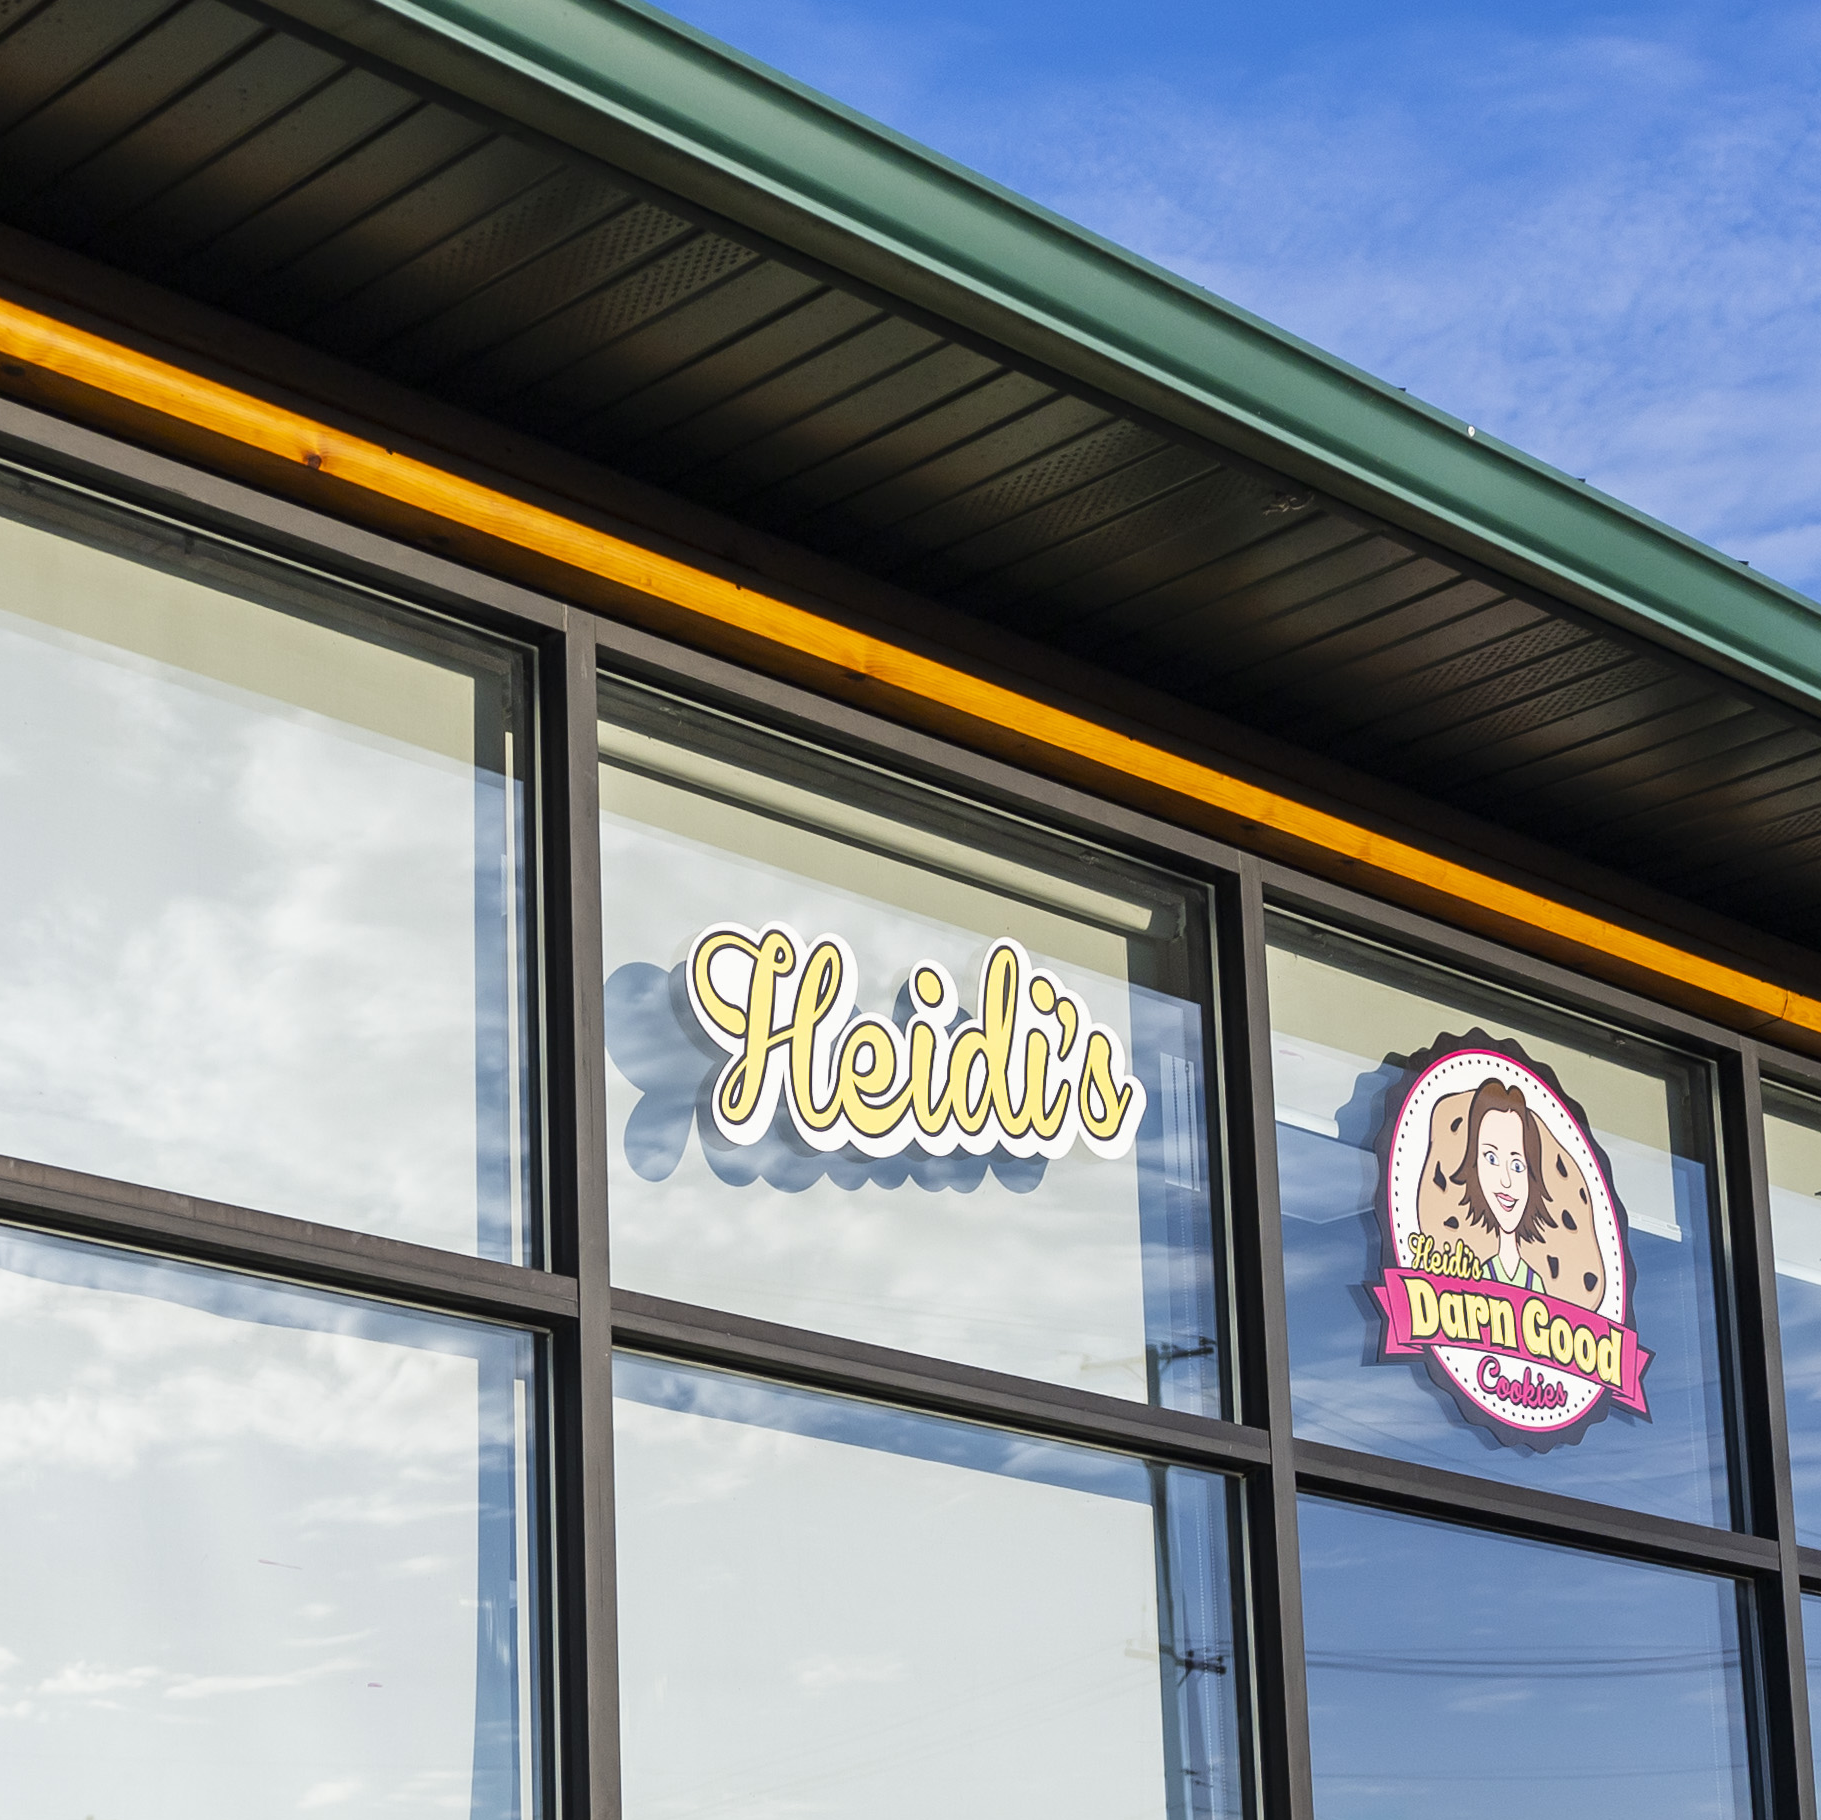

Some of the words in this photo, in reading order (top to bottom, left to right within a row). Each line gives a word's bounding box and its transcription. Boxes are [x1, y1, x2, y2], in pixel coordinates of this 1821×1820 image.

[691, 928, 1134, 1142] Heidi's
[1408, 1232, 1483, 1281] Heidi's
[1401, 1275, 1520, 1351] Darn
[1521, 1297, 1625, 1389] Good
[1477, 1355, 1568, 1409] Cookies
